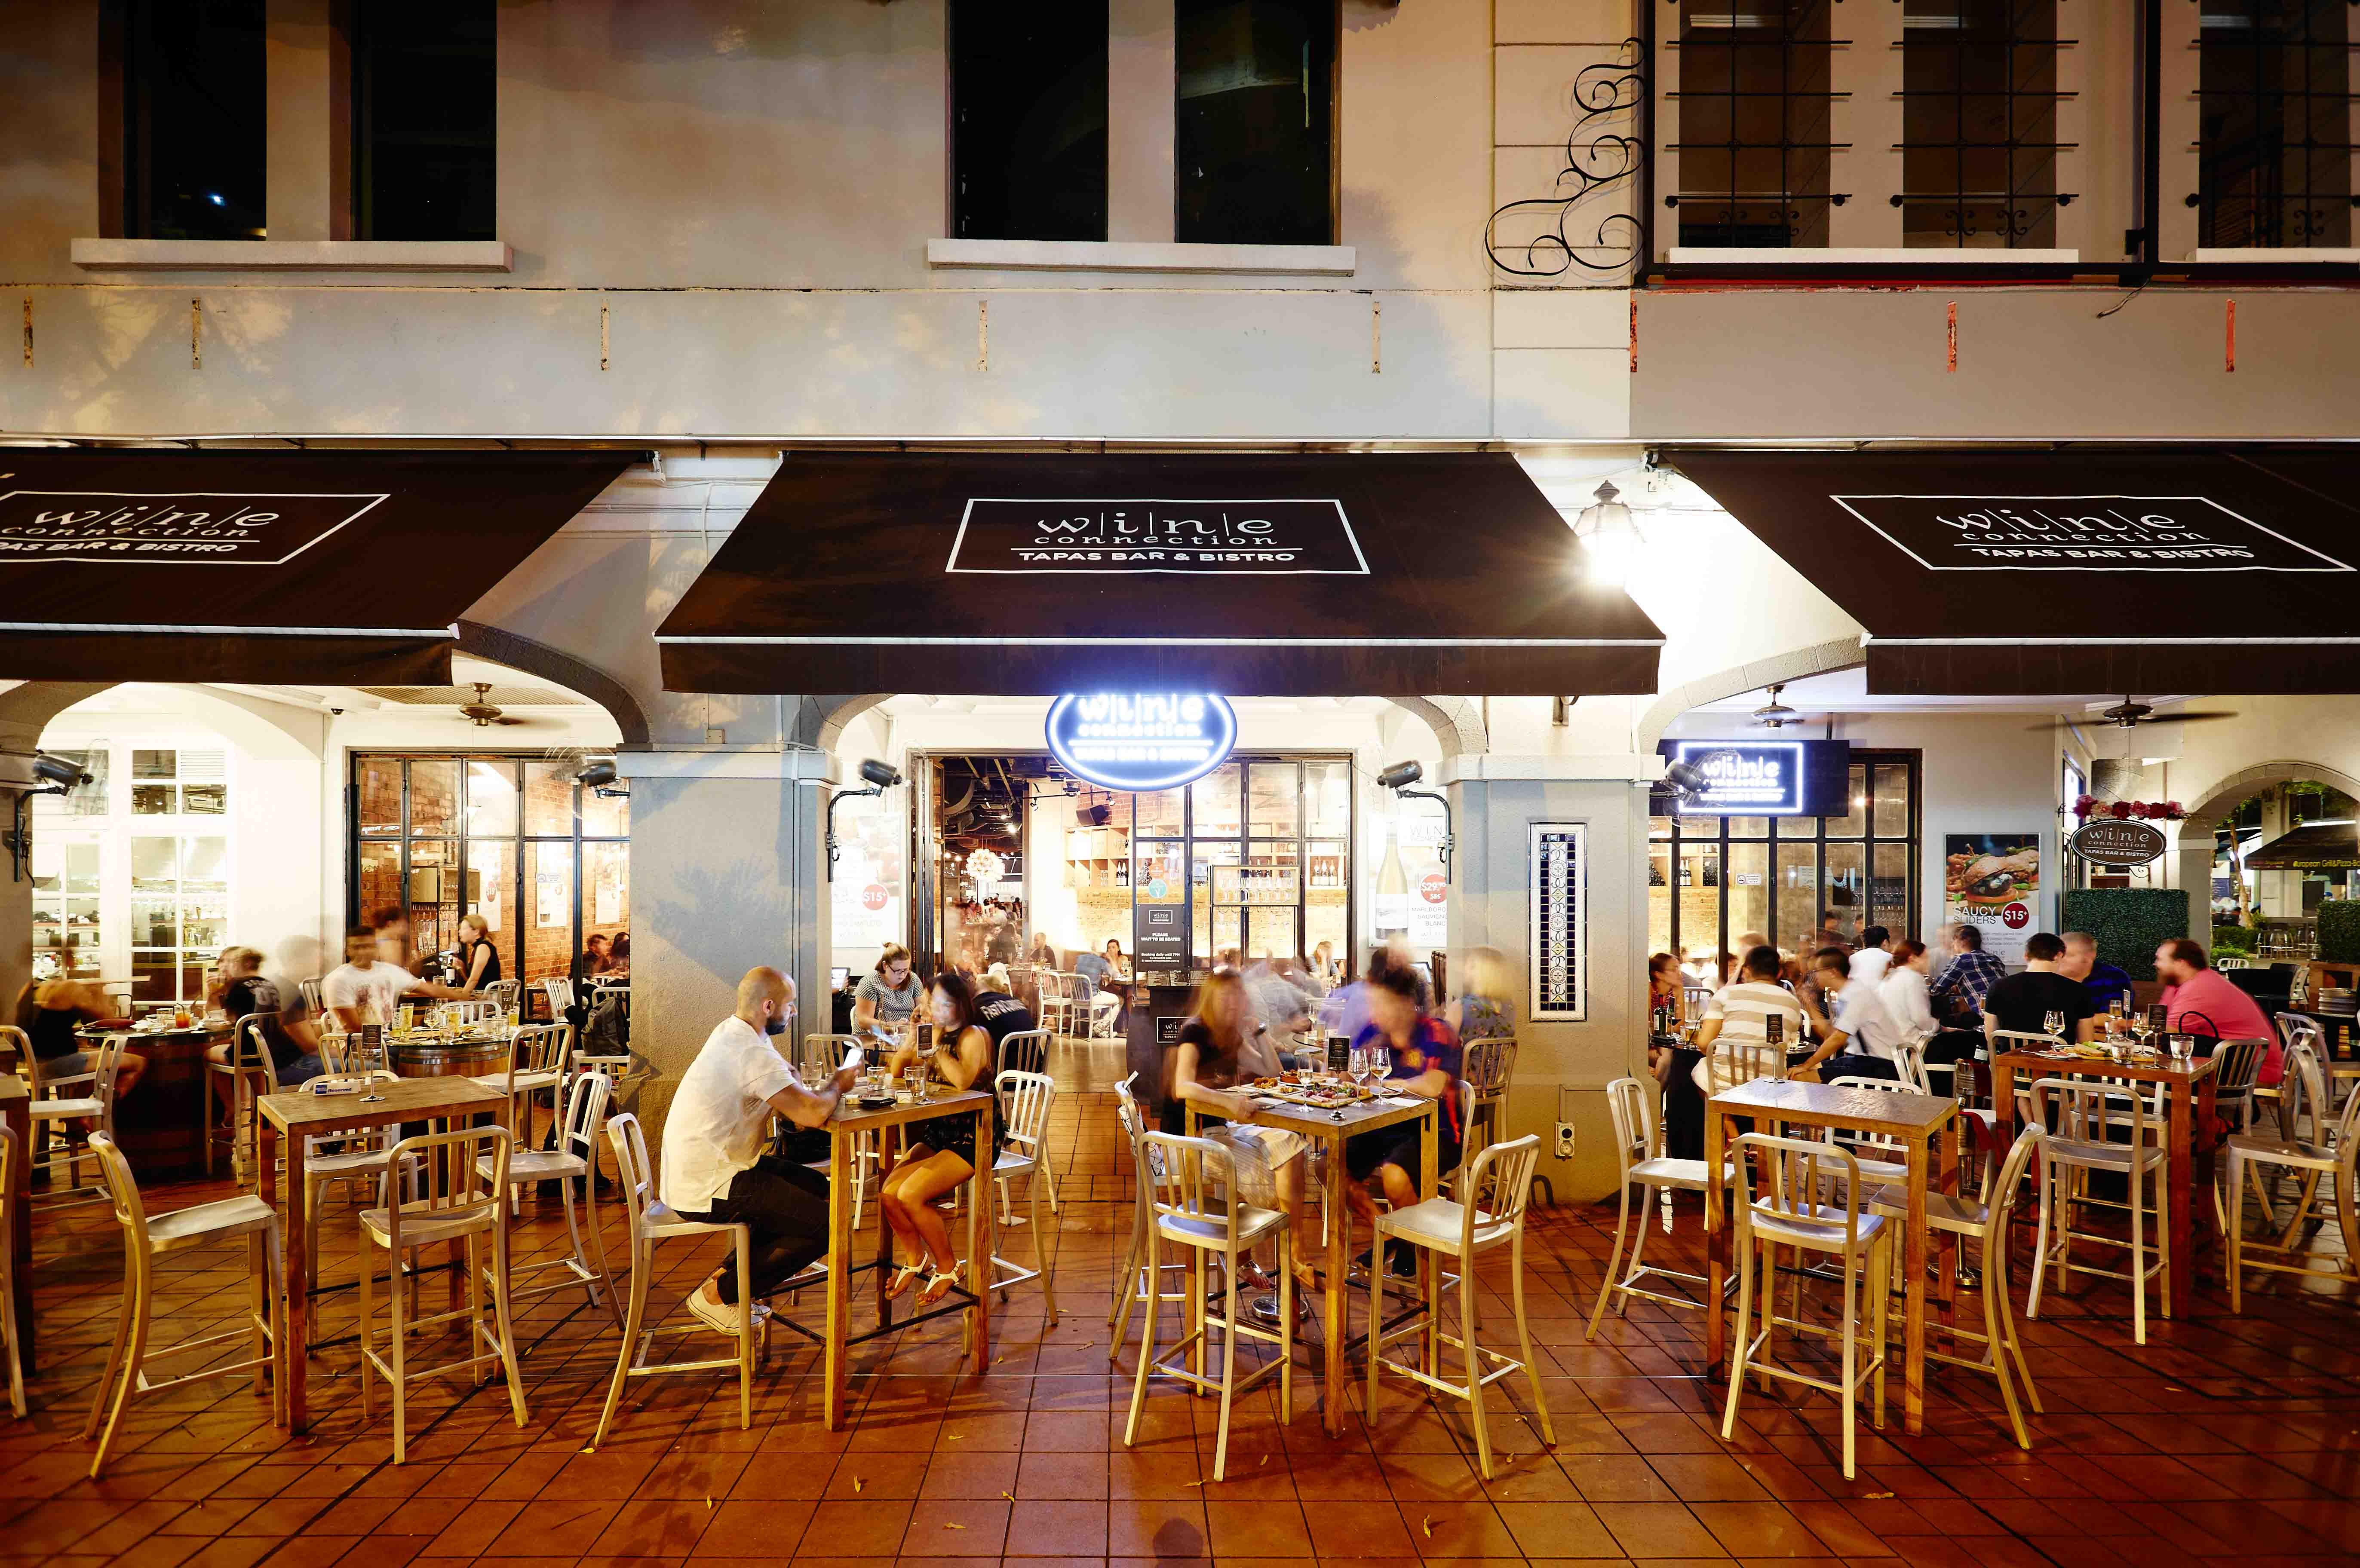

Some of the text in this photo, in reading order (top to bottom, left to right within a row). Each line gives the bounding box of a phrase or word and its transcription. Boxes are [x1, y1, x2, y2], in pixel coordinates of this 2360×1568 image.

[2, 527, 248, 536] connection
[1962, 531, 2210, 541] connection
[1034, 535, 1277, 545] connection
[45, 541, 107, 550] BAR
[135, 543, 238, 552] BISTRO
[1019, 551, 1295, 561] TAPAS BAR & BISTRO
[1971, 548, 2062, 557] TAPAS
[2152, 549, 2254, 558] BISTRO
[1953, 906, 1997, 916] SAUCY
